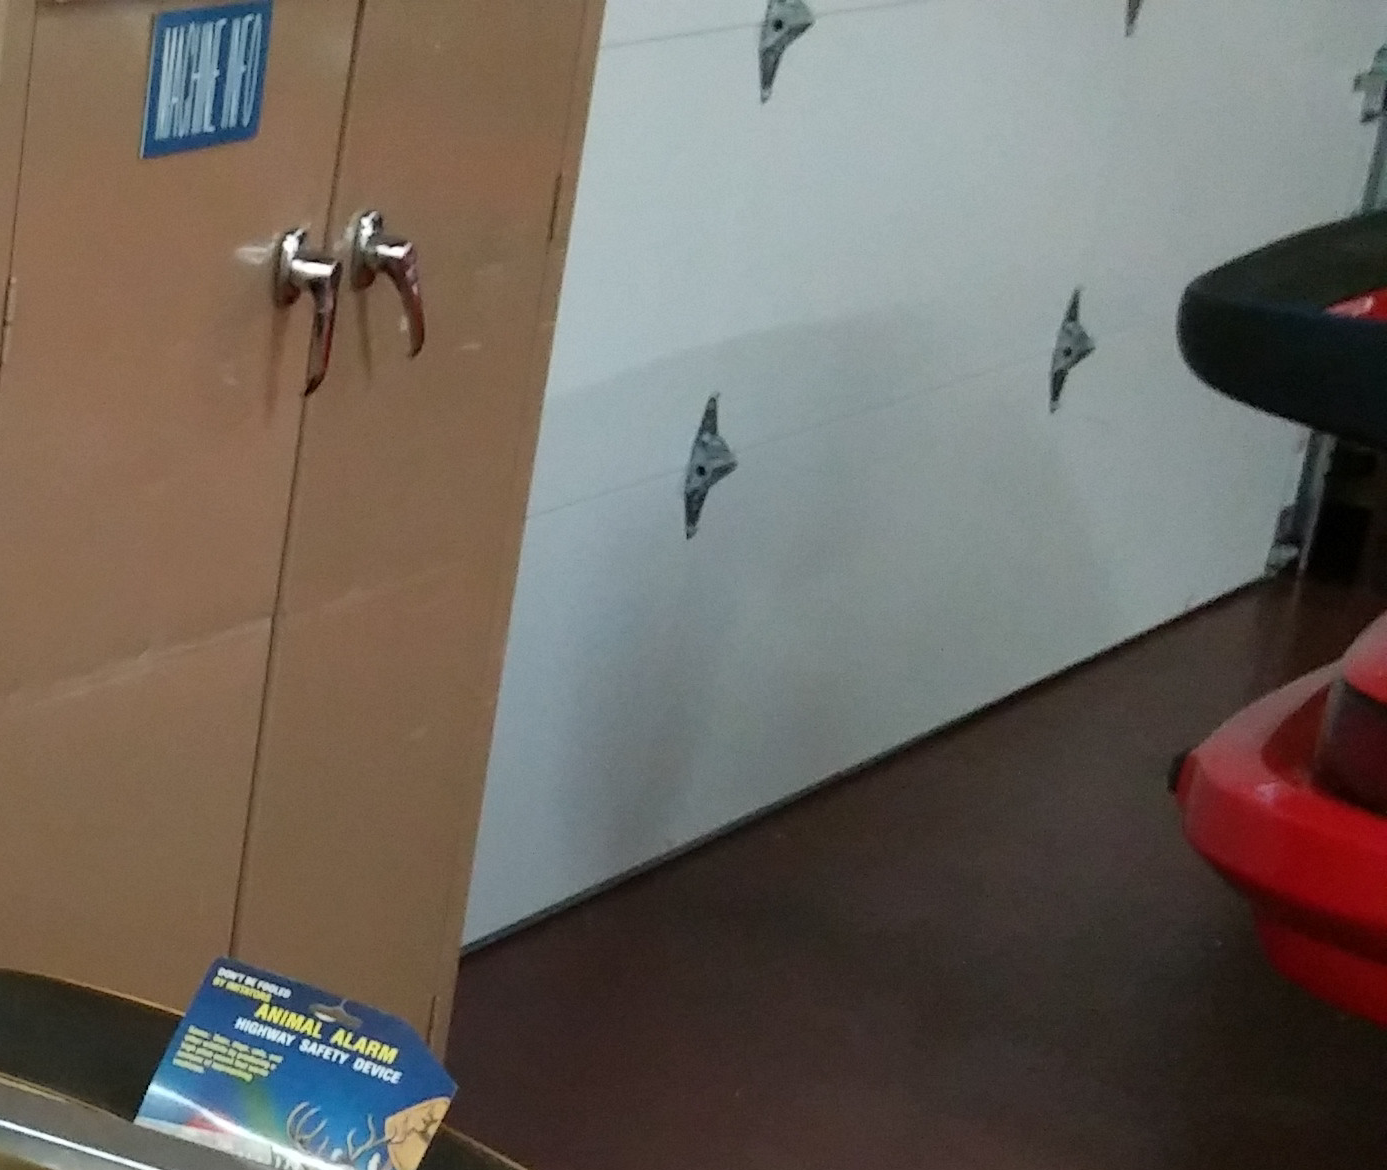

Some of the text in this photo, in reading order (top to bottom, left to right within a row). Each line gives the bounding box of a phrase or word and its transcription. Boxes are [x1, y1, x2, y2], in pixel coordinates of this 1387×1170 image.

[235, 1017, 297, 1047] HIGHWAY
[299, 1039, 352, 1065] SAFETY
[353, 1058, 404, 1085] DEVICE
[254, 1003, 399, 1065] ANIMAL ALARM
